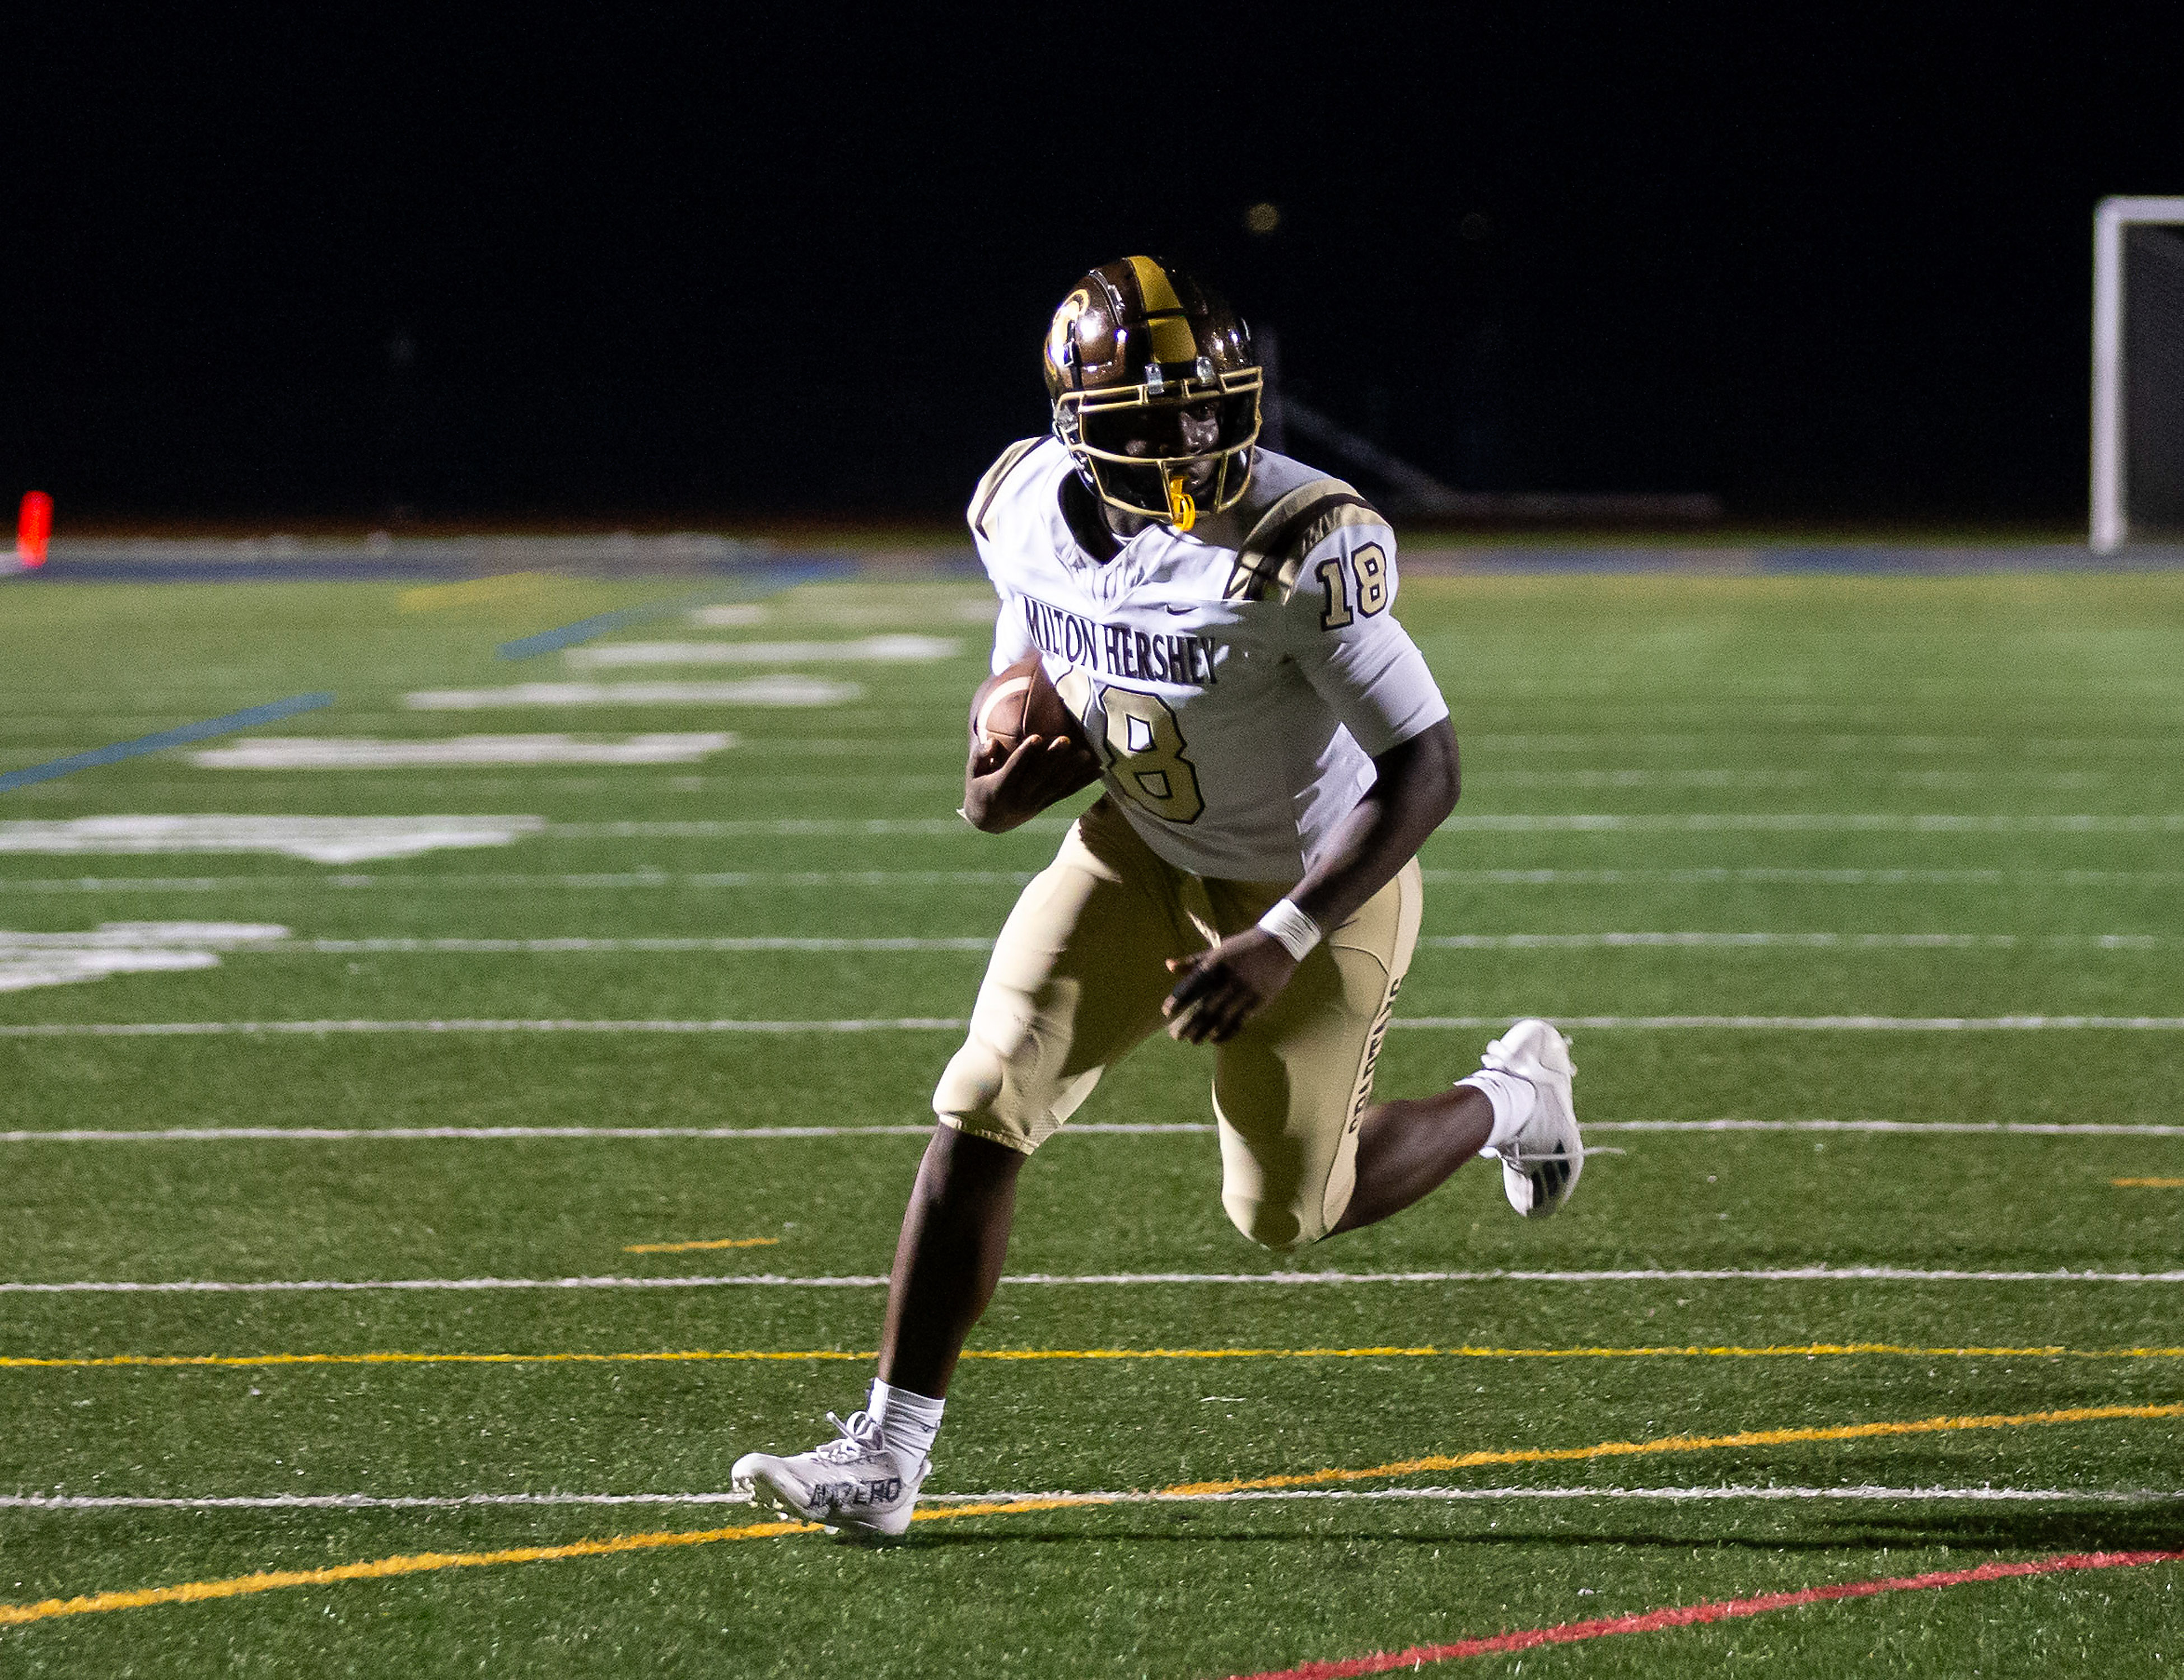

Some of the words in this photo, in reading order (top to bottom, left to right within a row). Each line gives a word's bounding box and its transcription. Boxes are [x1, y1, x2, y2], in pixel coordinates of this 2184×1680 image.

[1315, 541, 1388, 631] 18
[1023, 595, 1099, 671] MILTON
[1102, 623, 1218, 684] HERSHEY
